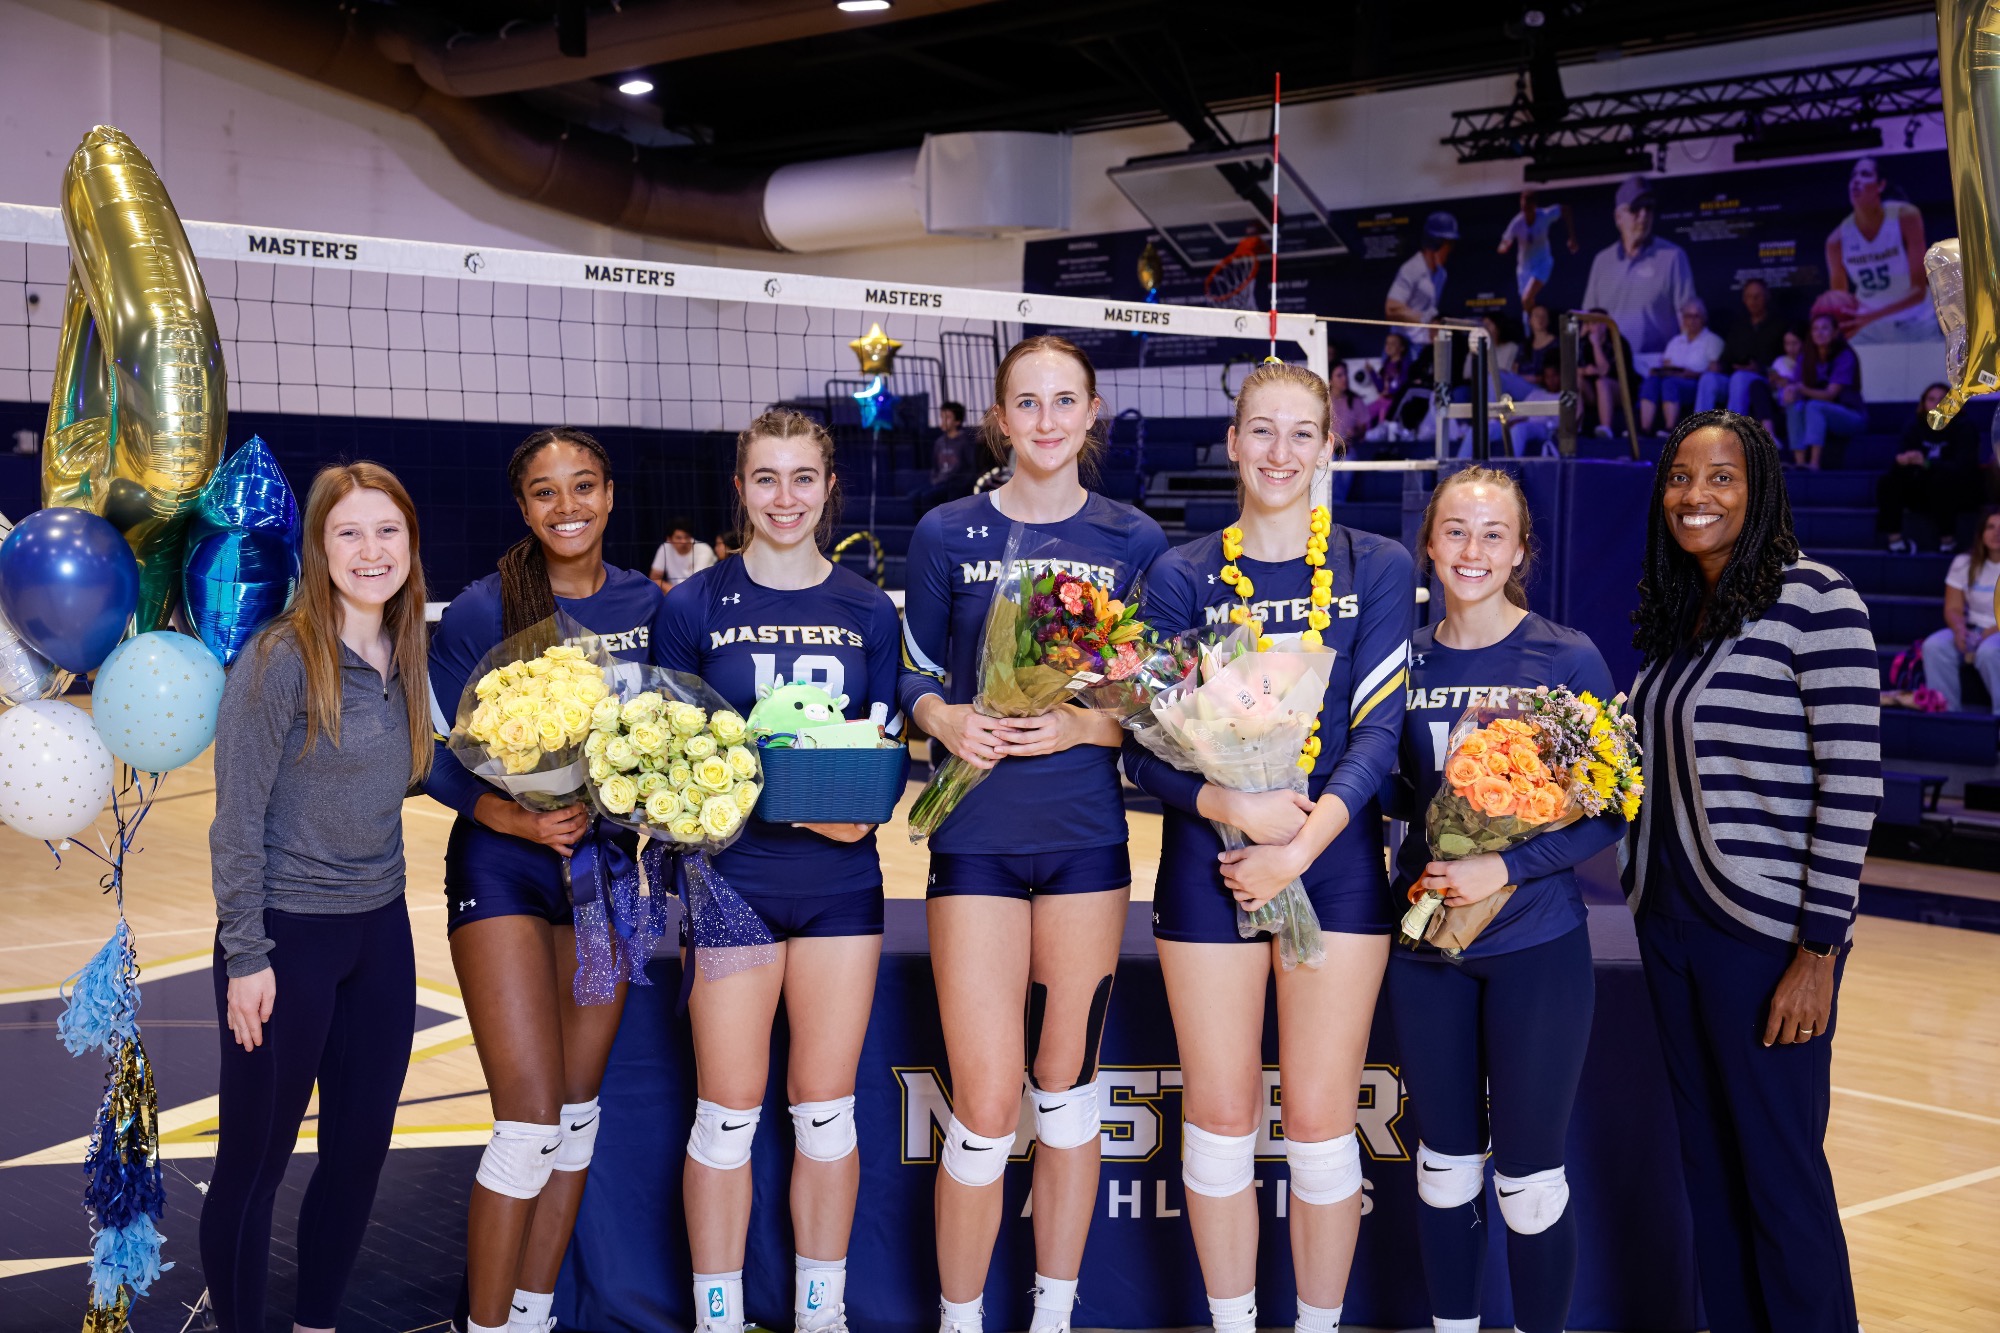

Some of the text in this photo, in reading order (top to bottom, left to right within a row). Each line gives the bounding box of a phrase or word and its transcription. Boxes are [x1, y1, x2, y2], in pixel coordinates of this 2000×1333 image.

[248, 234, 358, 261] MASTER'S
[584, 263, 676, 287] MASTER'S
[1858, 265, 1891, 291] 25
[865, 287, 943, 308] MASTER'S
[1104, 306, 1171, 326] MASTER'S
[709, 625, 864, 650] MASTER'S
